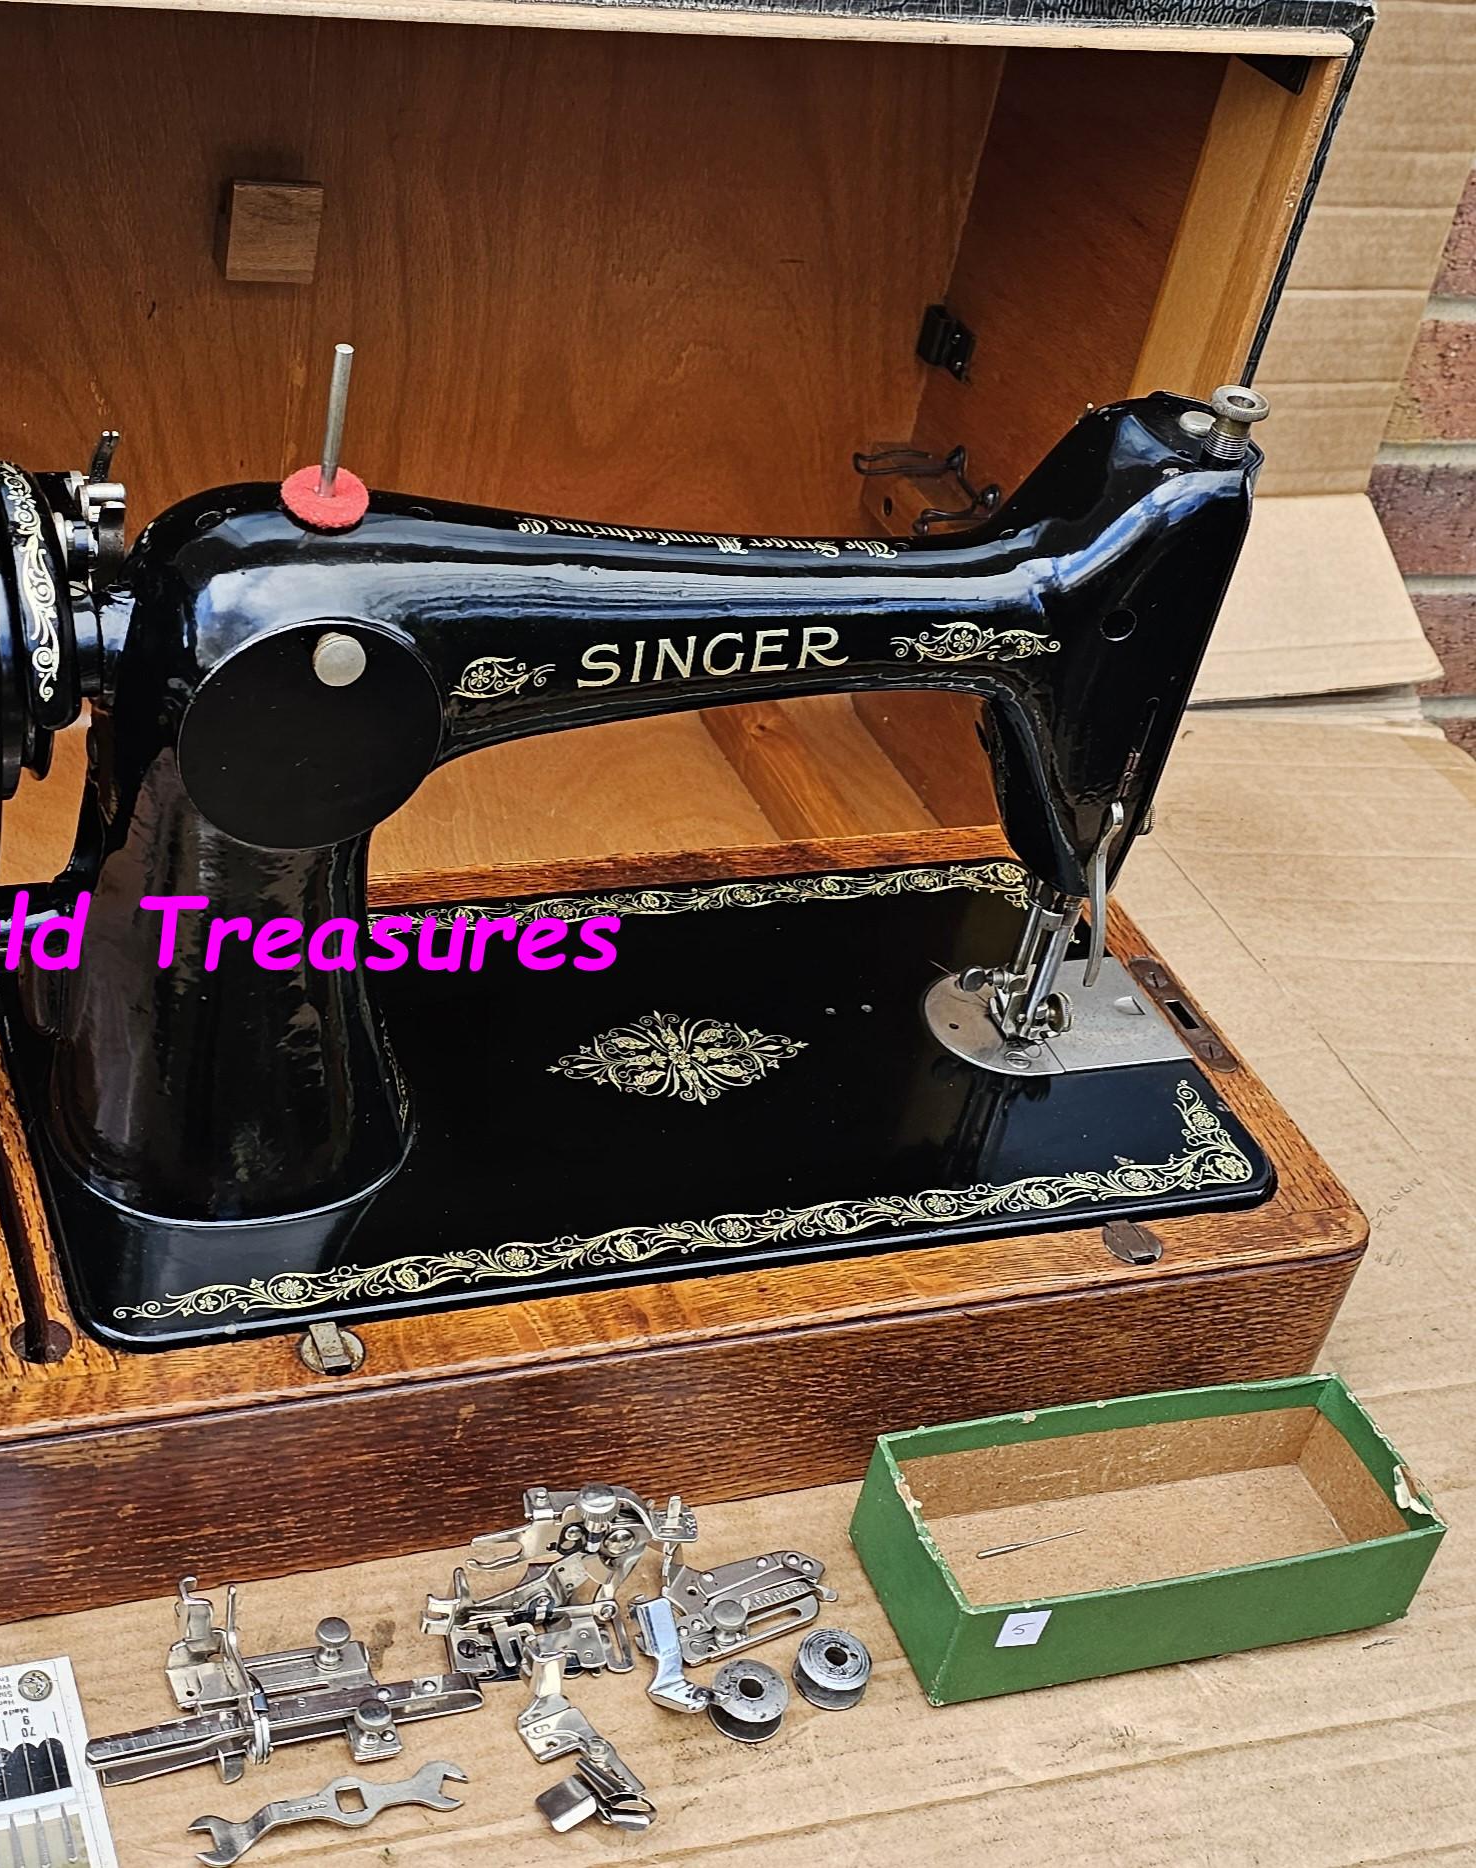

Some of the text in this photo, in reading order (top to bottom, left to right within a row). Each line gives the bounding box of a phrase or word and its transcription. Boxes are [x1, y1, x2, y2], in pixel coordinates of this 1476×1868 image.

[550, 518, 748, 555] Manufacturing
[748, 536, 840, 558] Singer
[844, 539, 898, 559] The
[576, 625, 849, 688] SINGER
[2, 1707, 29, 1718] Made
[22, 1715, 30, 1726] 9
[21, 1726, 37, 1738] 70
